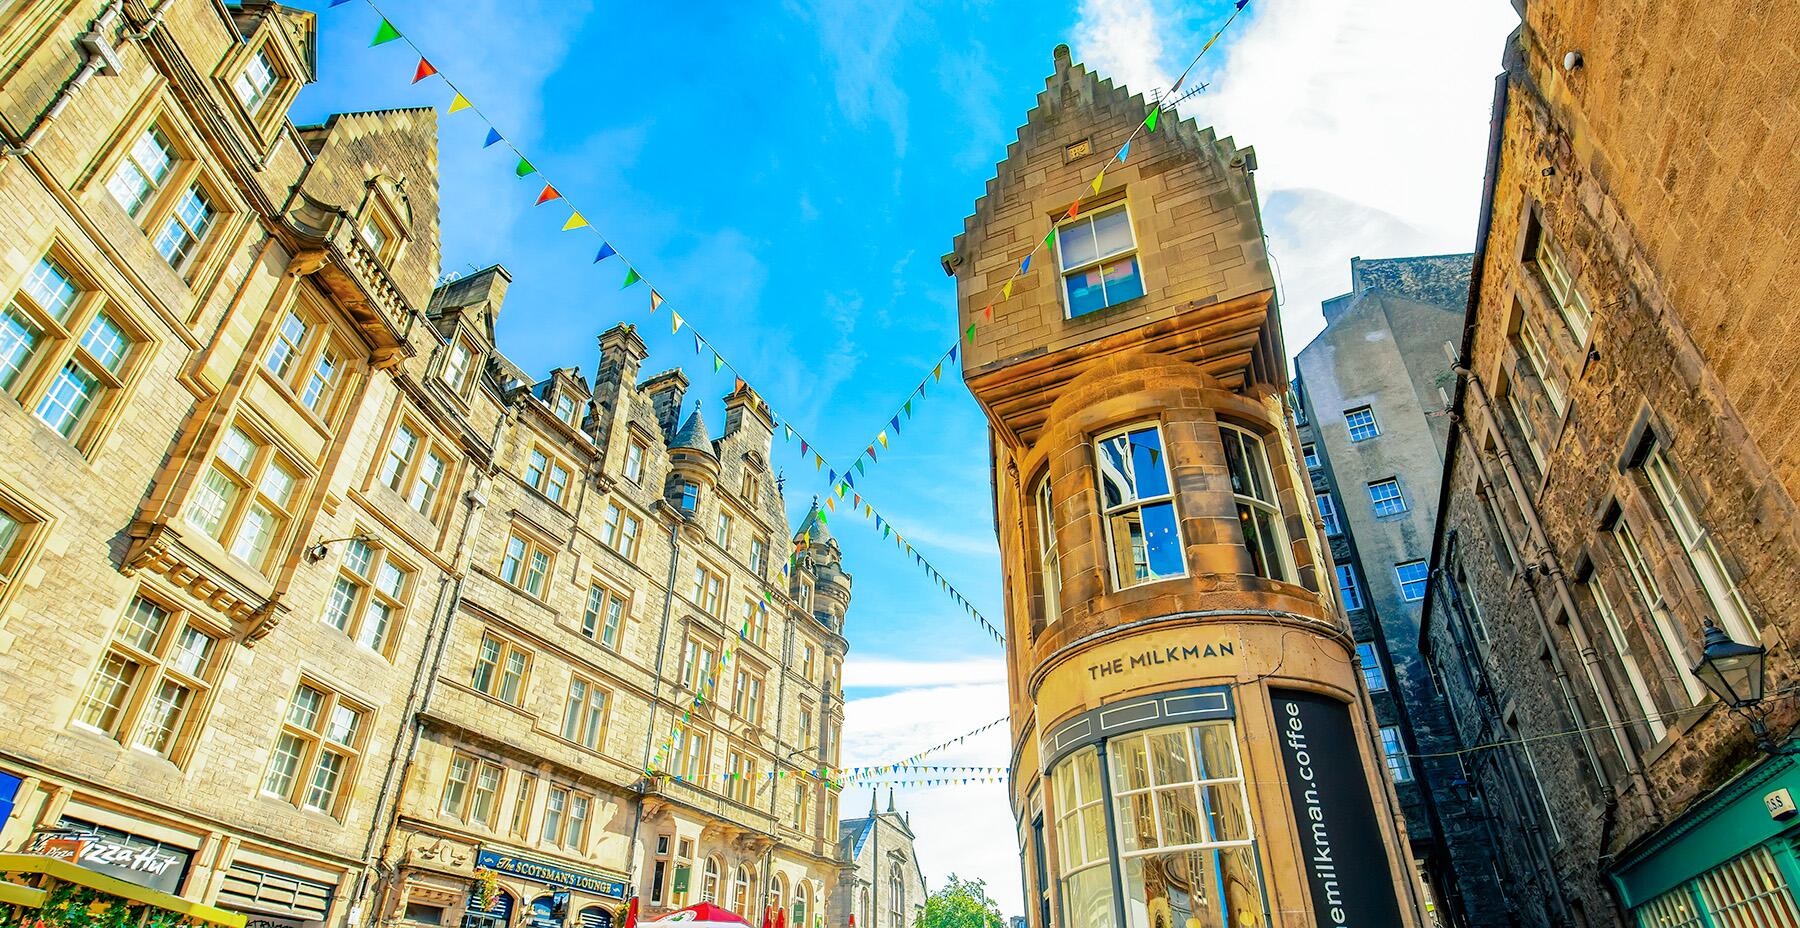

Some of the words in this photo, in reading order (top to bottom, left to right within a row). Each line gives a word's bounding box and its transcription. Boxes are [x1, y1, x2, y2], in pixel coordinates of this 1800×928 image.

[1088, 658, 1123, 680] THE
[1130, 642, 1235, 669] MILKMAN
[1286, 702, 1348, 928] emilkman.coffee
[130, 846, 180, 875] Hut
[496, 857, 515, 870] The
[515, 862, 575, 884] SCOTSMAN'S
[576, 876, 612, 893] LOUNGE
